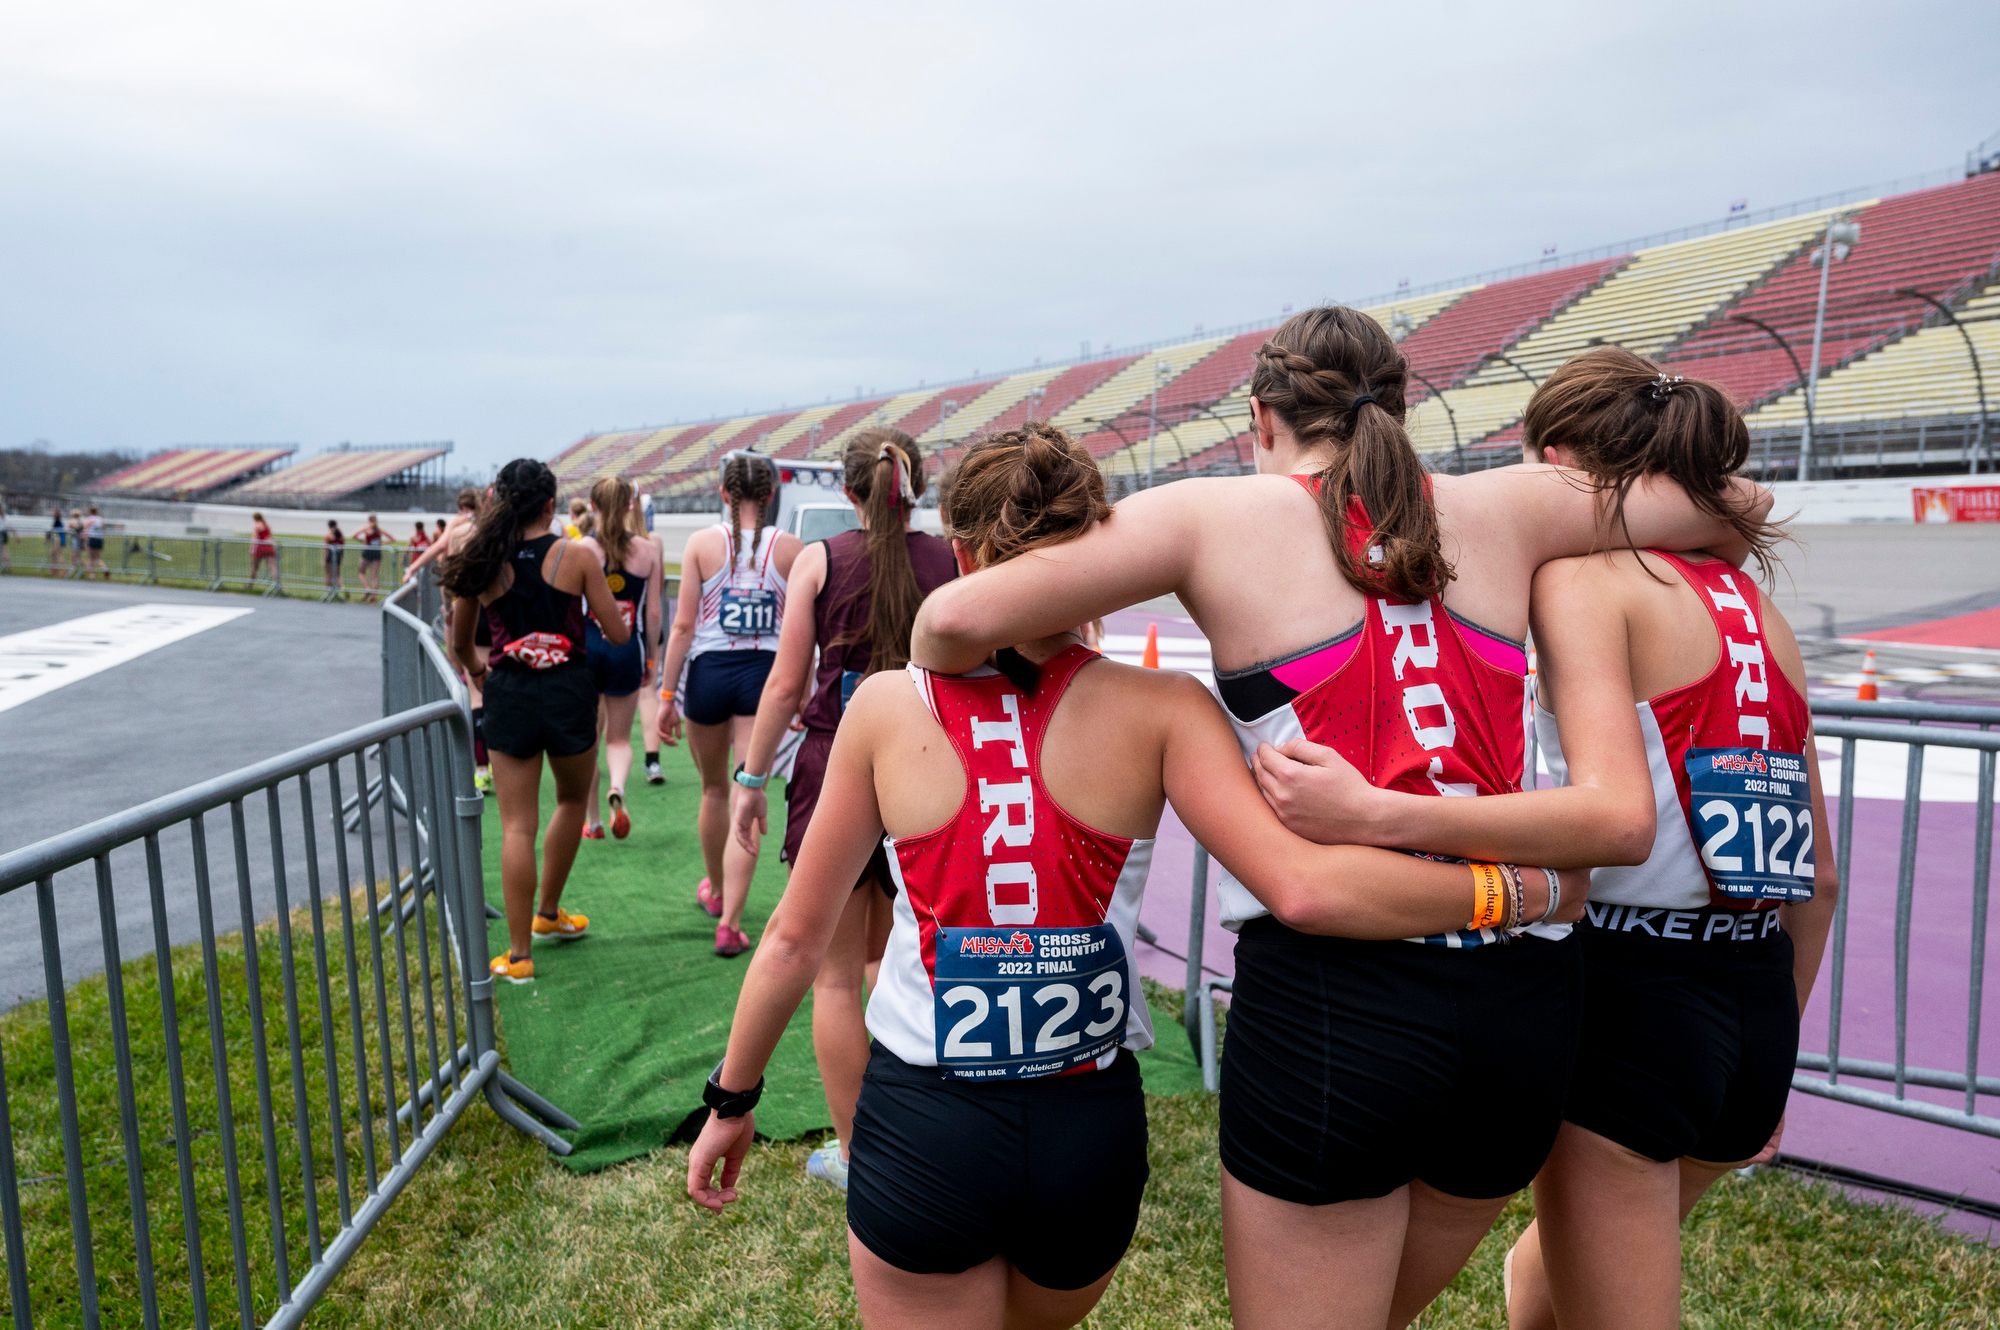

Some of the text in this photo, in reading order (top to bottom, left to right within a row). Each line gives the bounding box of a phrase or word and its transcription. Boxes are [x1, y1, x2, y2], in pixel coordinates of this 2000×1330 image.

[723, 603, 773, 628] 2111
[1712, 754, 1764, 773] MHSAA
[1769, 756, 1800, 770] CROSS
[1771, 768, 1807, 783] COUNTRY
[1744, 779, 1792, 796] 2022 FINAL
[1699, 800, 1815, 878] 2122
[1728, 884, 1739, 892] ON
[1739, 884, 1754, 893] BACK
[1583, 900, 1700, 941] NIKE
[960, 935, 1026, 954] MHSAA
[1039, 933, 1091, 946] CROSS
[1039, 938, 1106, 958] COUNTRY
[998, 960, 1076, 975] 2022 FINAL
[941, 970, 1125, 1058] 2123
[1073, 1039, 1115, 1063] WEAR ON BACK
[954, 1068, 1007, 1078] WEAR ON BACK
